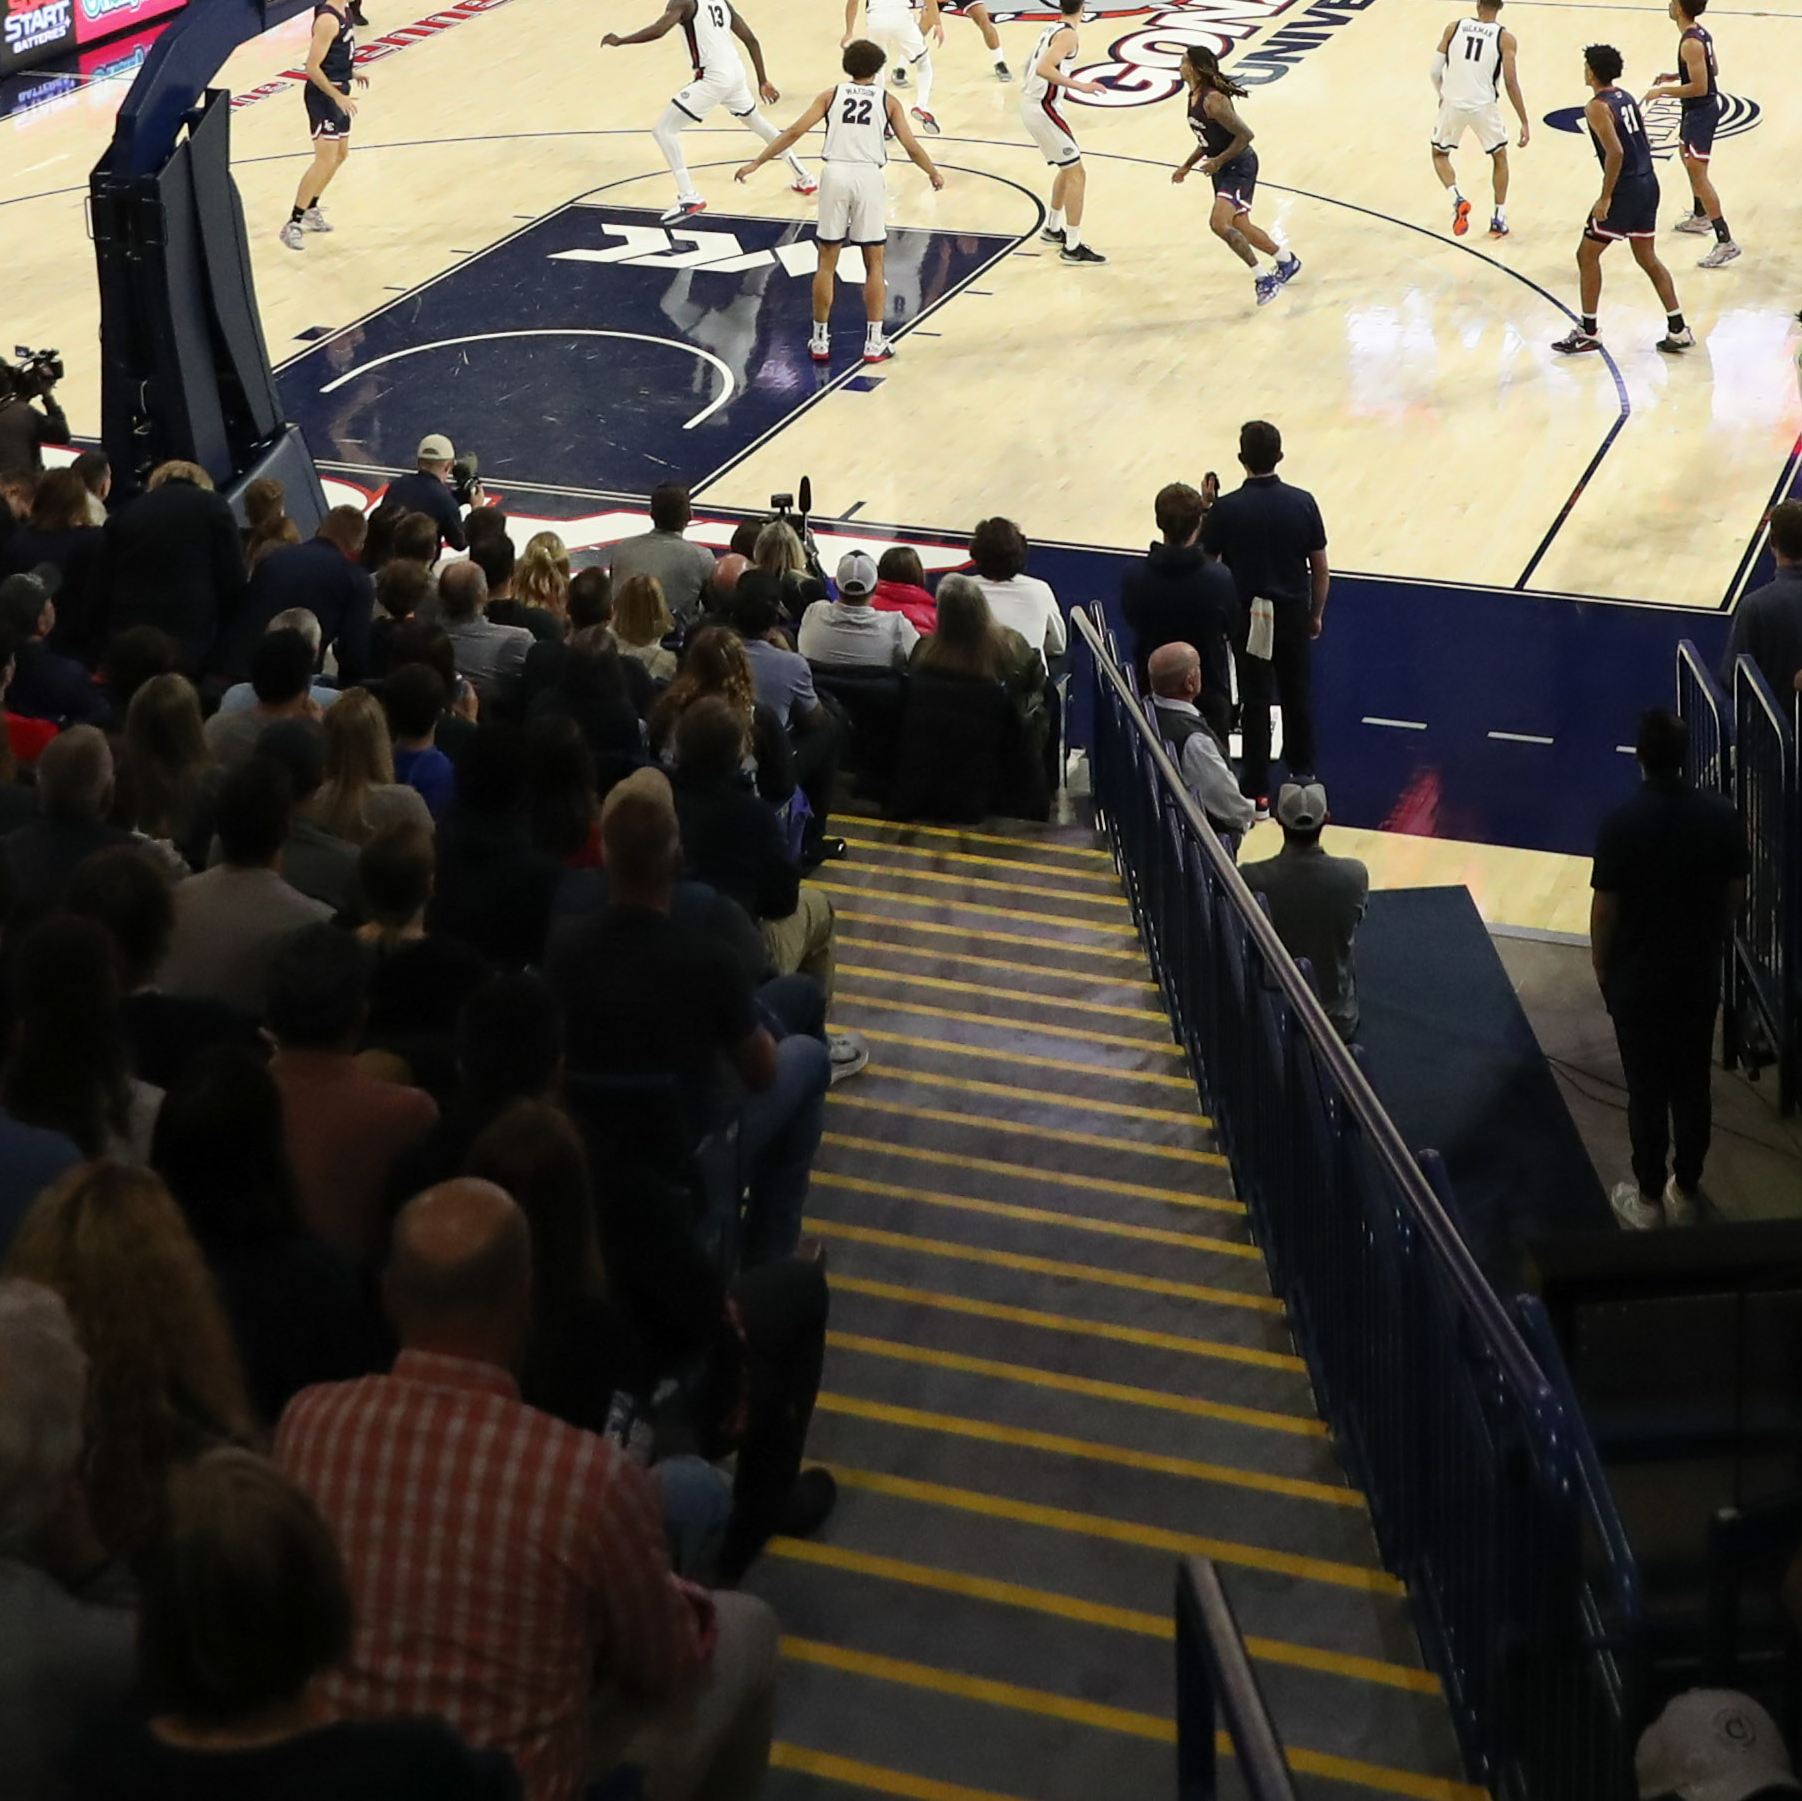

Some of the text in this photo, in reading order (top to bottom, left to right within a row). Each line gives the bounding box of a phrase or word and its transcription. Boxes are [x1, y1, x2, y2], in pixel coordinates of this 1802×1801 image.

[708, 4, 725, 28] 13
[13, 26, 67, 54] BATTERIES
[1464, 36, 1484, 62] 11
[842, 97, 873, 126] 22
[1621, 103, 1640, 135] 21
